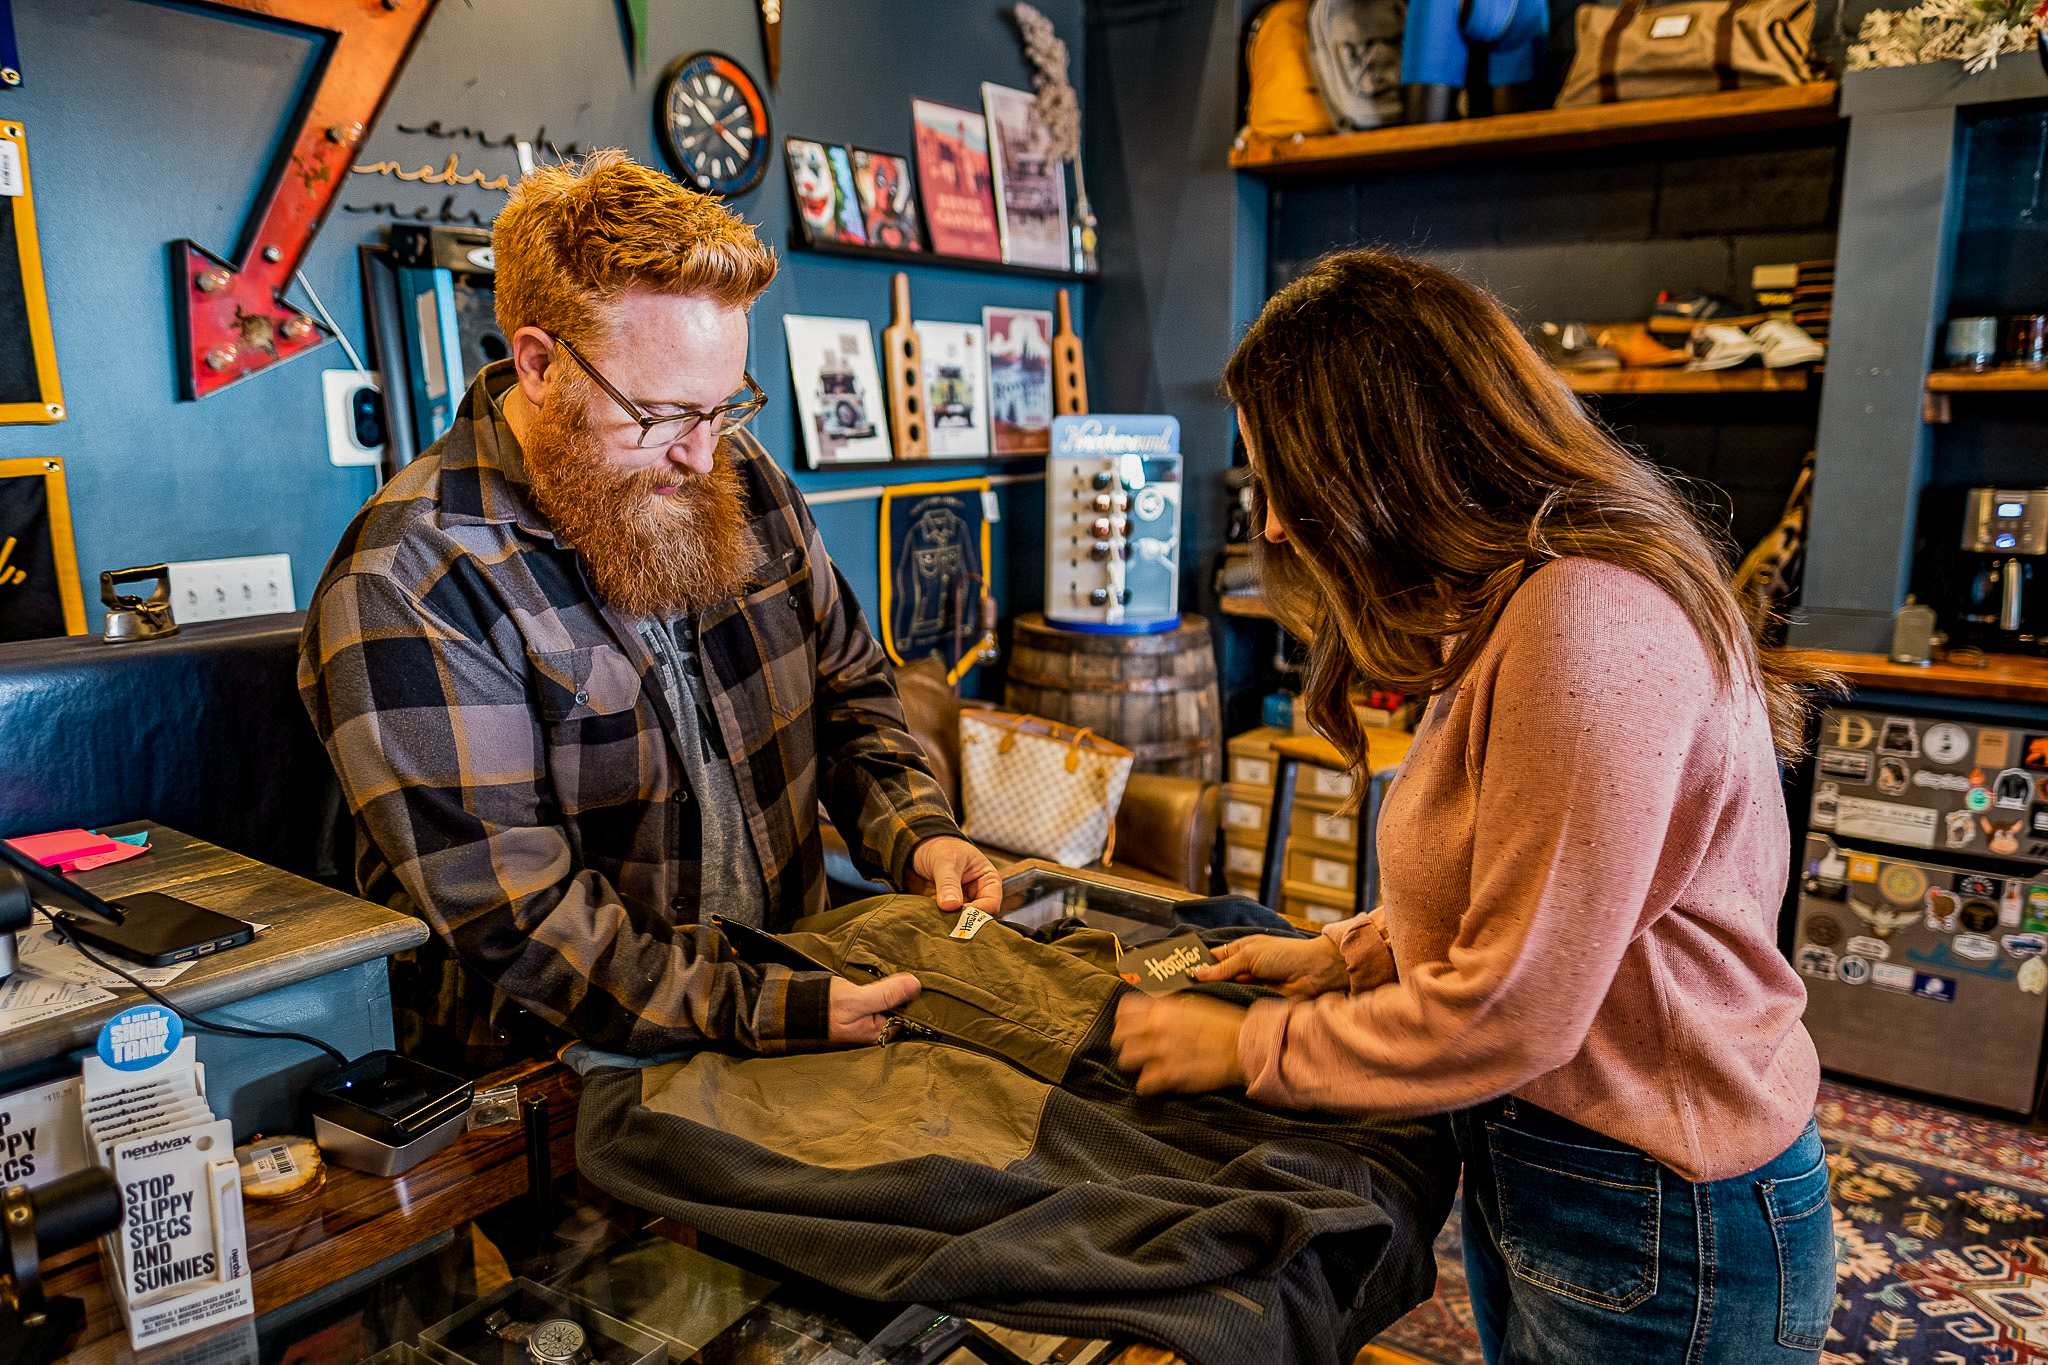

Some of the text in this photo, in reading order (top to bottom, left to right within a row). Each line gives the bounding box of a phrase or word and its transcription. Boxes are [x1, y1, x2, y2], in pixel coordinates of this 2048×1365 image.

[1143, 946, 1201, 983] Howler
[110, 1016, 170, 1043] SHARK
[111, 1033, 170, 1064] TANK
[122, 1135, 193, 1160] nerdwax
[126, 1173, 175, 1205] STOP
[127, 1190, 195, 1228] SLIPPY
[130, 1214, 192, 1250] SPECS
[133, 1242, 173, 1273] AND
[134, 1252, 216, 1295] SUNNIES
